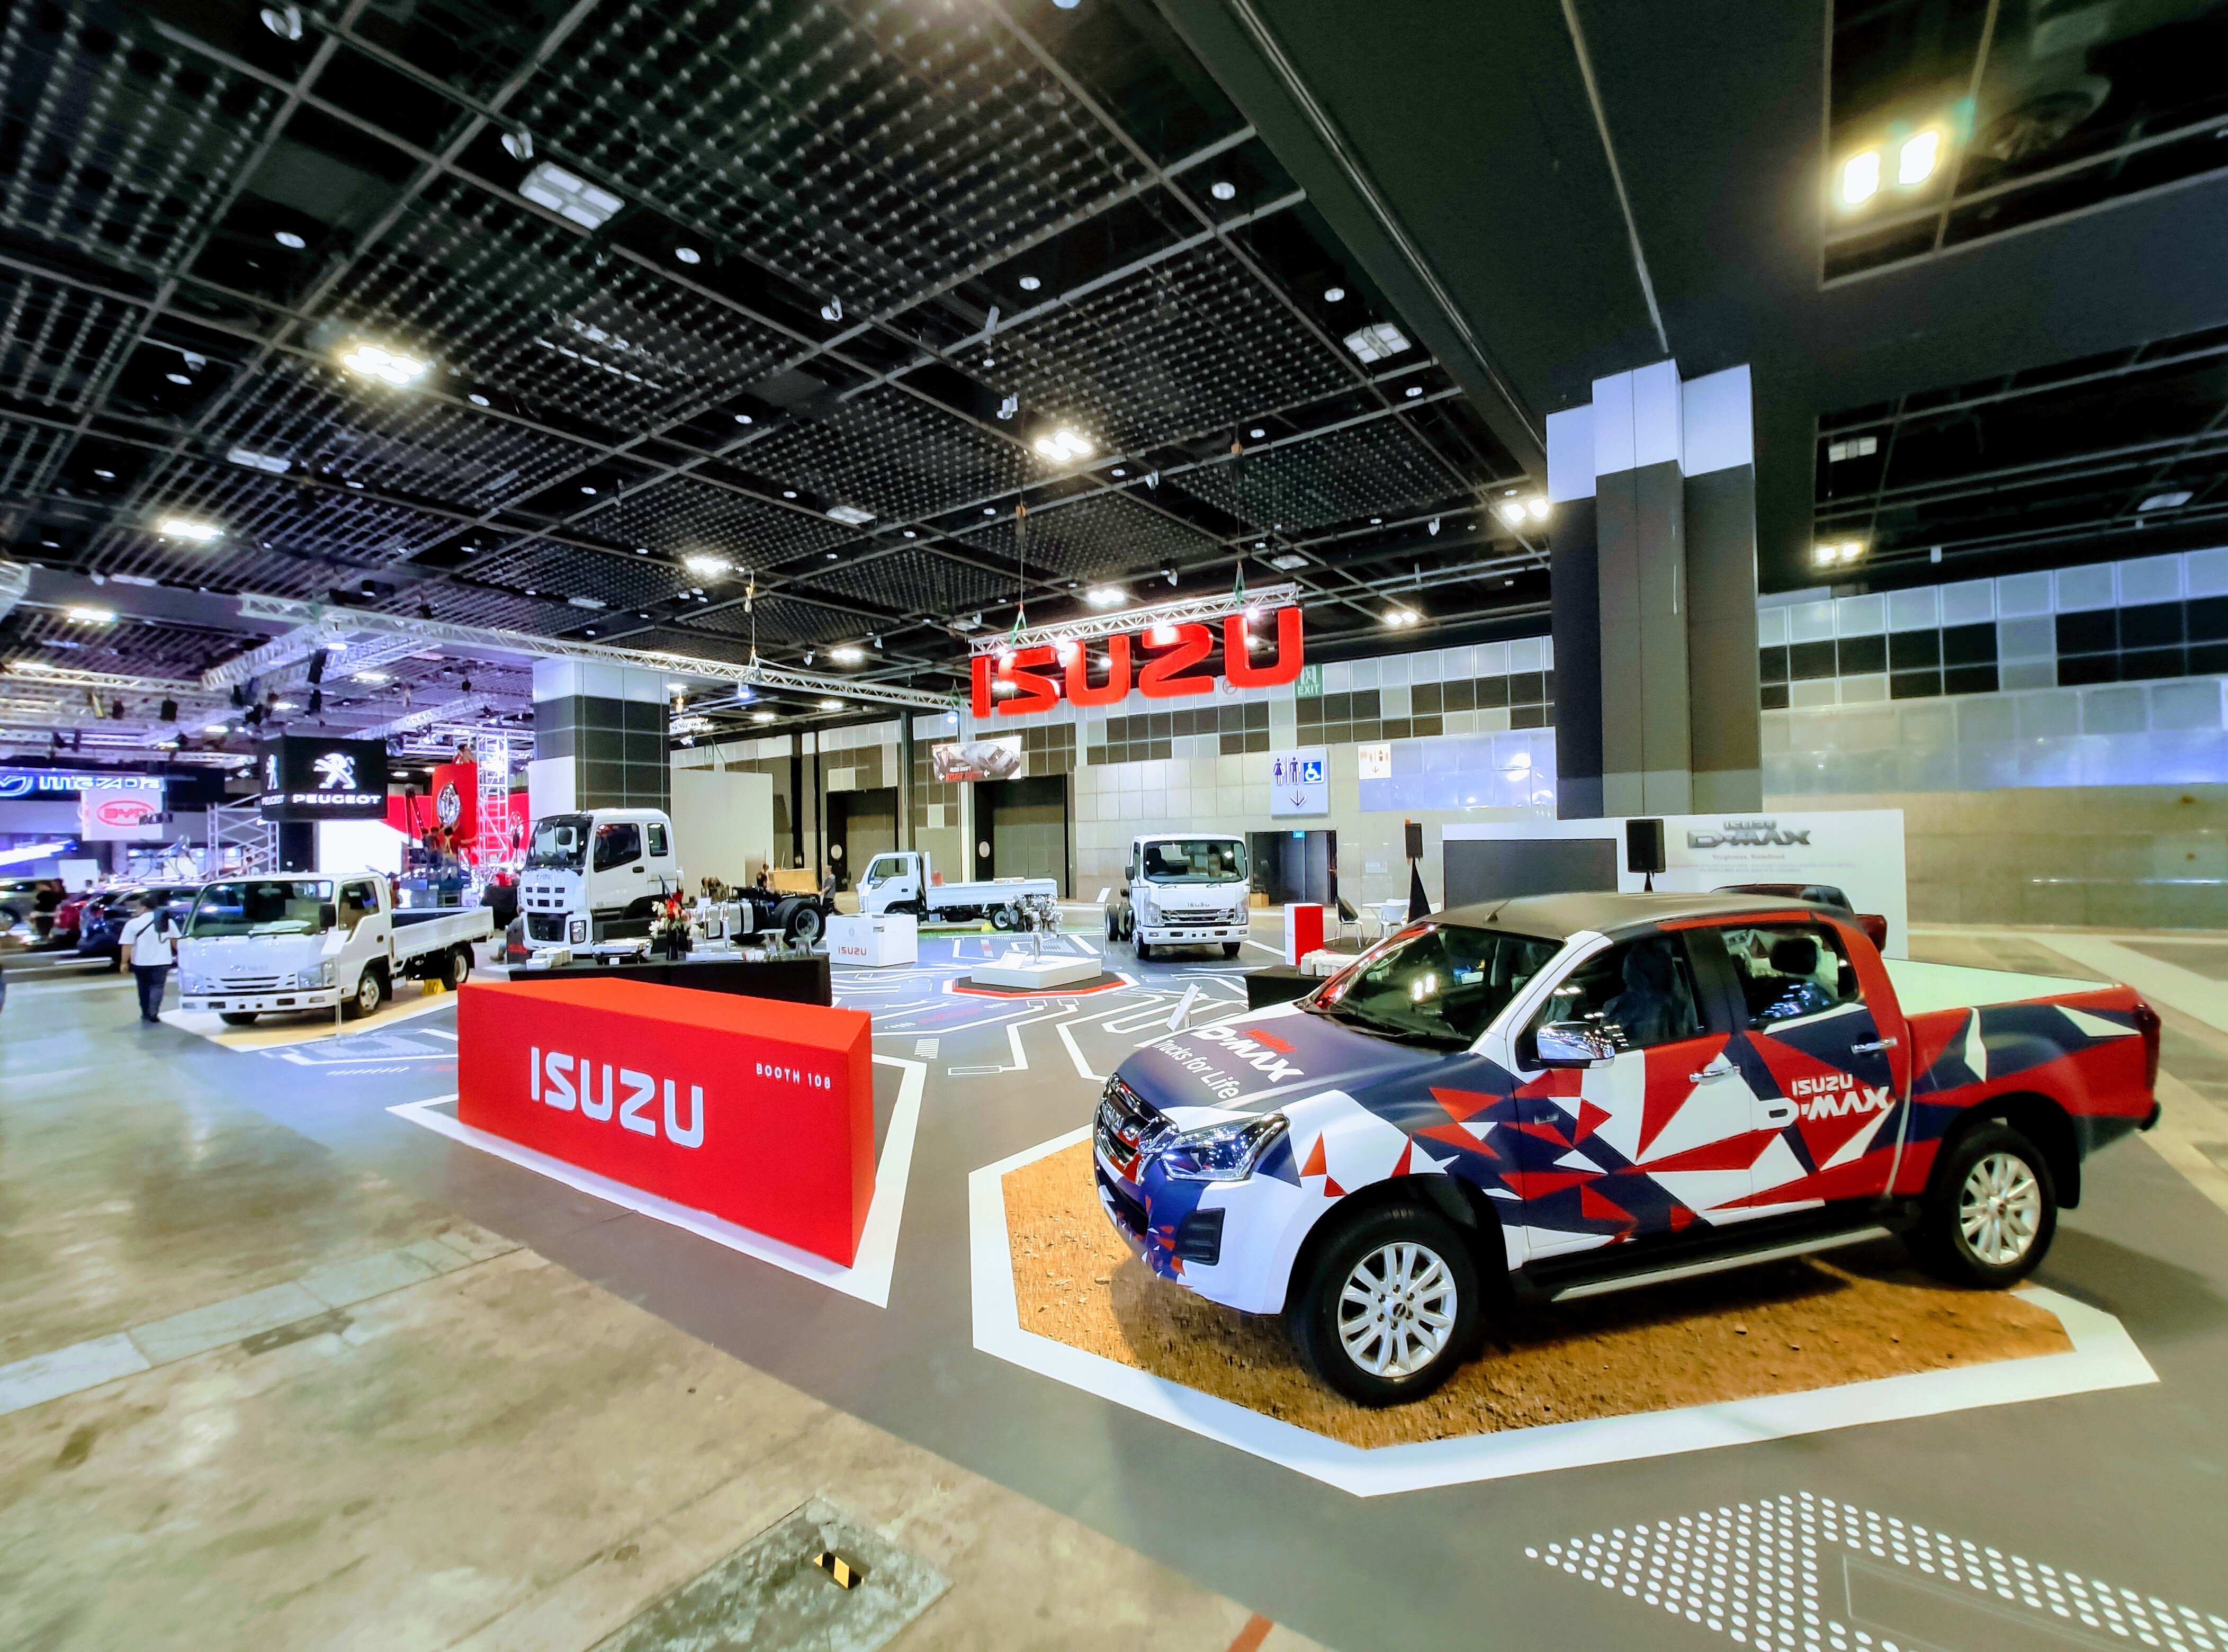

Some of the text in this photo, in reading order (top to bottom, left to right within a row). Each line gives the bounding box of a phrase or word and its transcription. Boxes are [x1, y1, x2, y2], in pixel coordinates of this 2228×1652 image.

[971, 606, 1304, 719] ISUZU
[1297, 684, 1320, 696] EXIT
[292, 793, 382, 805] PEUGEOT
[838, 946, 867, 956] ISUZU
[756, 1063, 831, 1090] BOOTH 108
[1152, 1039, 1241, 1099] Trucks for Life
[531, 1046, 704, 1148] ISUZU
[1791, 1074, 1853, 1096] ISUZU
